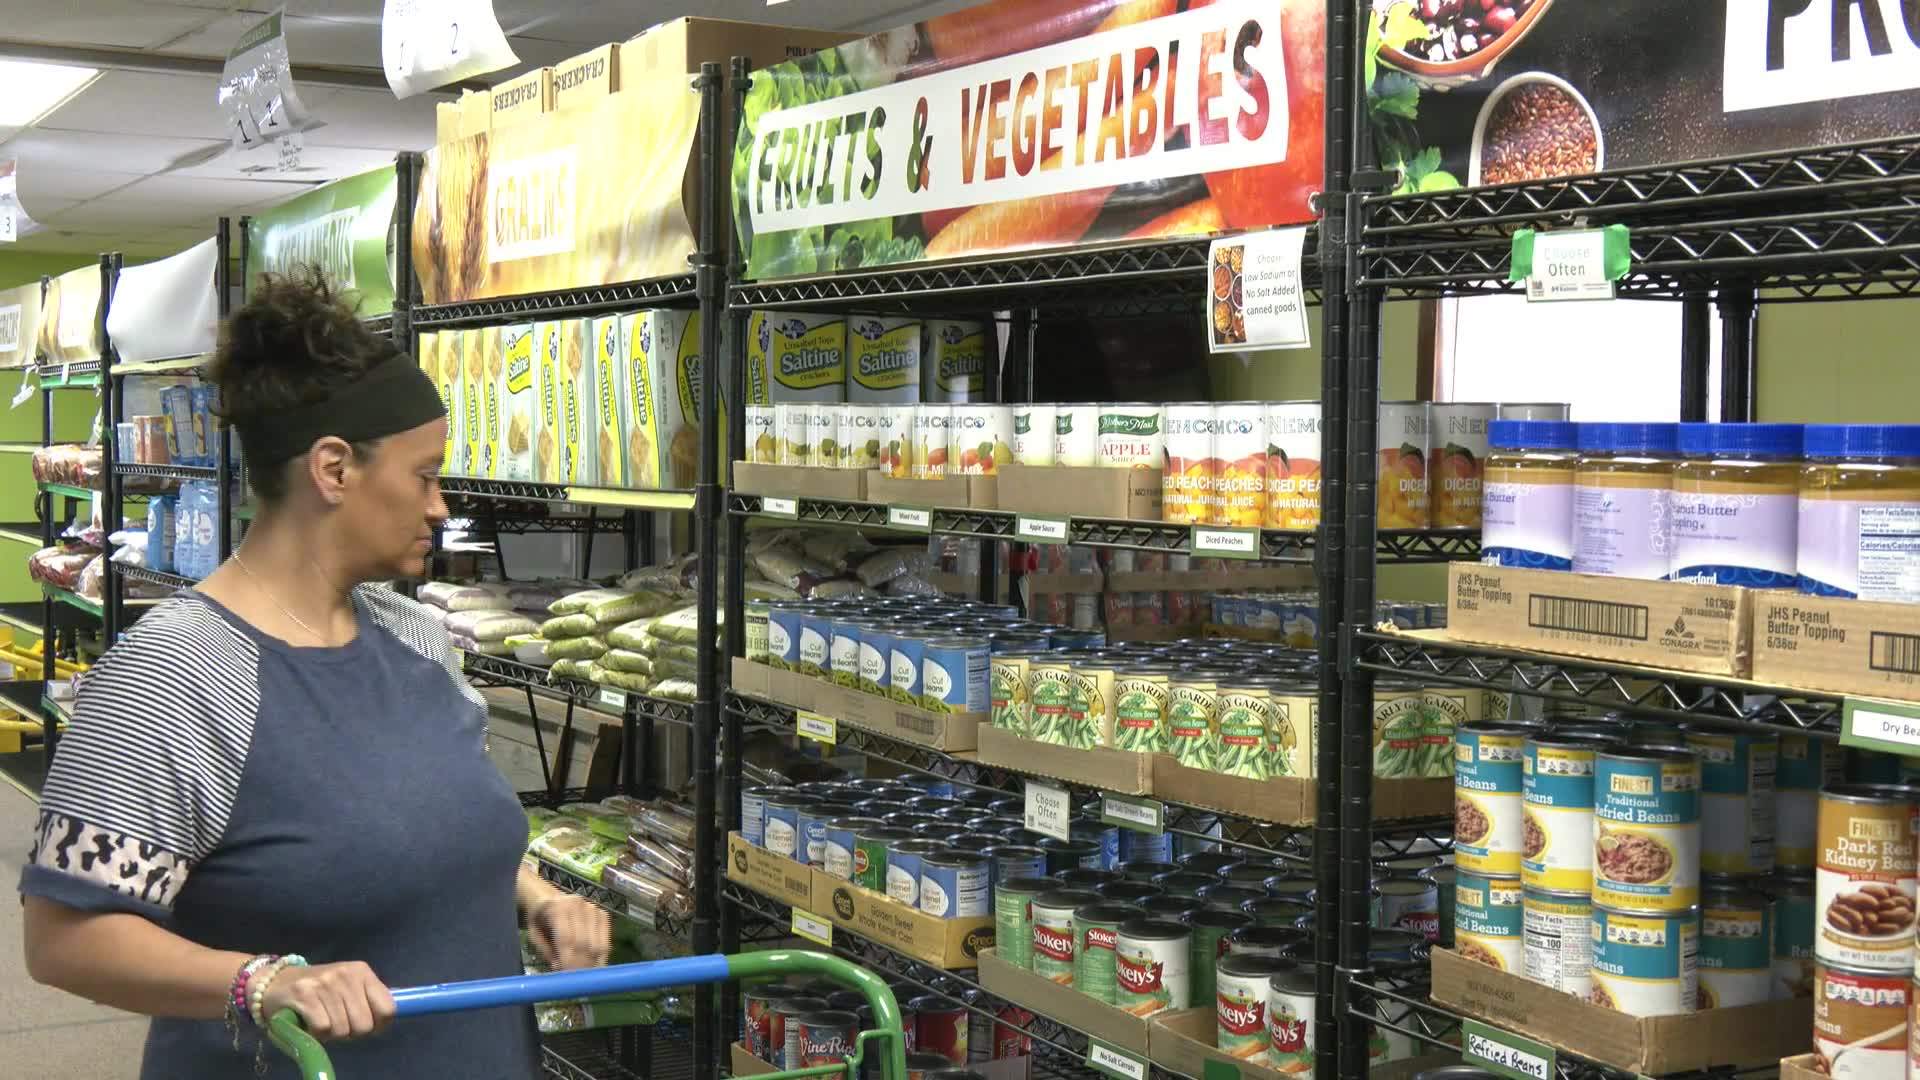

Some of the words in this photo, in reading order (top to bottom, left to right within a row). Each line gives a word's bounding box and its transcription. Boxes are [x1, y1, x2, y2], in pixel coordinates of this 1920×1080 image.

[451, 23, 458, 54] 2
[1765, 0, 1920, 72] PR
[555, 57, 605, 92] CRACKERS
[494, 80, 538, 112] CRACKERS
[756, 105, 887, 214] FRUITS
[907, 96, 933, 194] &
[961, 19, 1270, 184] VEGETABLES
[237, 120, 252, 143] 1
[495, 163, 568, 247] GRAINS
[1549, 263, 1585, 276] Often
[1246, 290, 1256, 298] No
[1257, 289, 1270, 298] Salt
[1272, 285, 1296, 296] Added
[1247, 304, 1272, 315] canned
[1274, 301, 1297, 315] goods
[509, 355, 531, 382] Saltine
[780, 348, 840, 375] Saltine
[860, 349, 914, 375] Saltine
[940, 357, 984, 377] Saltin
[600, 359, 611, 426] Saltine
[632, 357, 648, 426] Saltine
[747, 415, 773, 426] MCO
[840, 414, 877, 428] EMCO
[913, 415, 949, 428] EMCO
[949, 415, 985, 428] EMCO
[1215, 418, 1253, 434] MCO
[1269, 416, 1322, 434] NEM
[1101, 443, 1151, 455] APPLE
[1176, 475, 1214, 490] PEACH
[1215, 477, 1263, 492] PEACHES
[1444, 477, 1481, 491] DICED
[1163, 494, 1194, 505] ATURAL
[1196, 495, 1214, 505] JUIC
[1231, 496, 1255, 507] JUICE
[1489, 492, 1516, 504] Butter
[1697, 503, 1738, 516] Butter
[1206, 535, 1220, 544] Diced
[1221, 536, 1244, 546] Peaches
[1457, 573, 1473, 585] JHS
[1474, 575, 1501, 588] Peanut
[1457, 584, 1481, 599] Butter
[1482, 588, 1512, 605] Topping
[1767, 606, 1789, 621] JHS
[1792, 608, 1831, 625] Peanut
[1767, 620, 1800, 636] Butter
[1803, 623, 1846, 643] Topping
[1659, 638, 1700, 650] CONAGRA
[1073, 676, 1097, 703] ARDEN
[1234, 697, 1268, 718] GARDE
[1882, 721, 1900, 736] Dry
[1903, 724, 1920, 736] Bea
[1463, 776, 1497, 791] Beans
[1035, 792, 1060, 809] Choose
[1524, 787, 1553, 805] Beans
[1606, 793, 1659, 808] Traditional
[1038, 806, 1057, 819] Often
[1637, 809, 1680, 823] Beans
[1837, 836, 1878, 855] Dark
[1882, 841, 1913, 857] Red
[1825, 848, 1877, 871] Kidney
[1882, 856, 1917, 871] Bea
[1471, 920, 1509, 935] Beans
[1033, 928, 1073, 953] Stokely
[1088, 929, 1118, 946] Stokel
[1546, 939, 1561, 948] 100
[1593, 955, 1624, 975] Beans
[1217, 1002, 1257, 1027] kely's
[799, 1038, 827, 1056] Vine
[1469, 1035, 1507, 1065] Refried
[1511, 1051, 1543, 1075] Beans
[1100, 1051, 1108, 1061] No
[1108, 1055, 1117, 1065] Salt
[1118, 1059, 1136, 1073] Carrots
